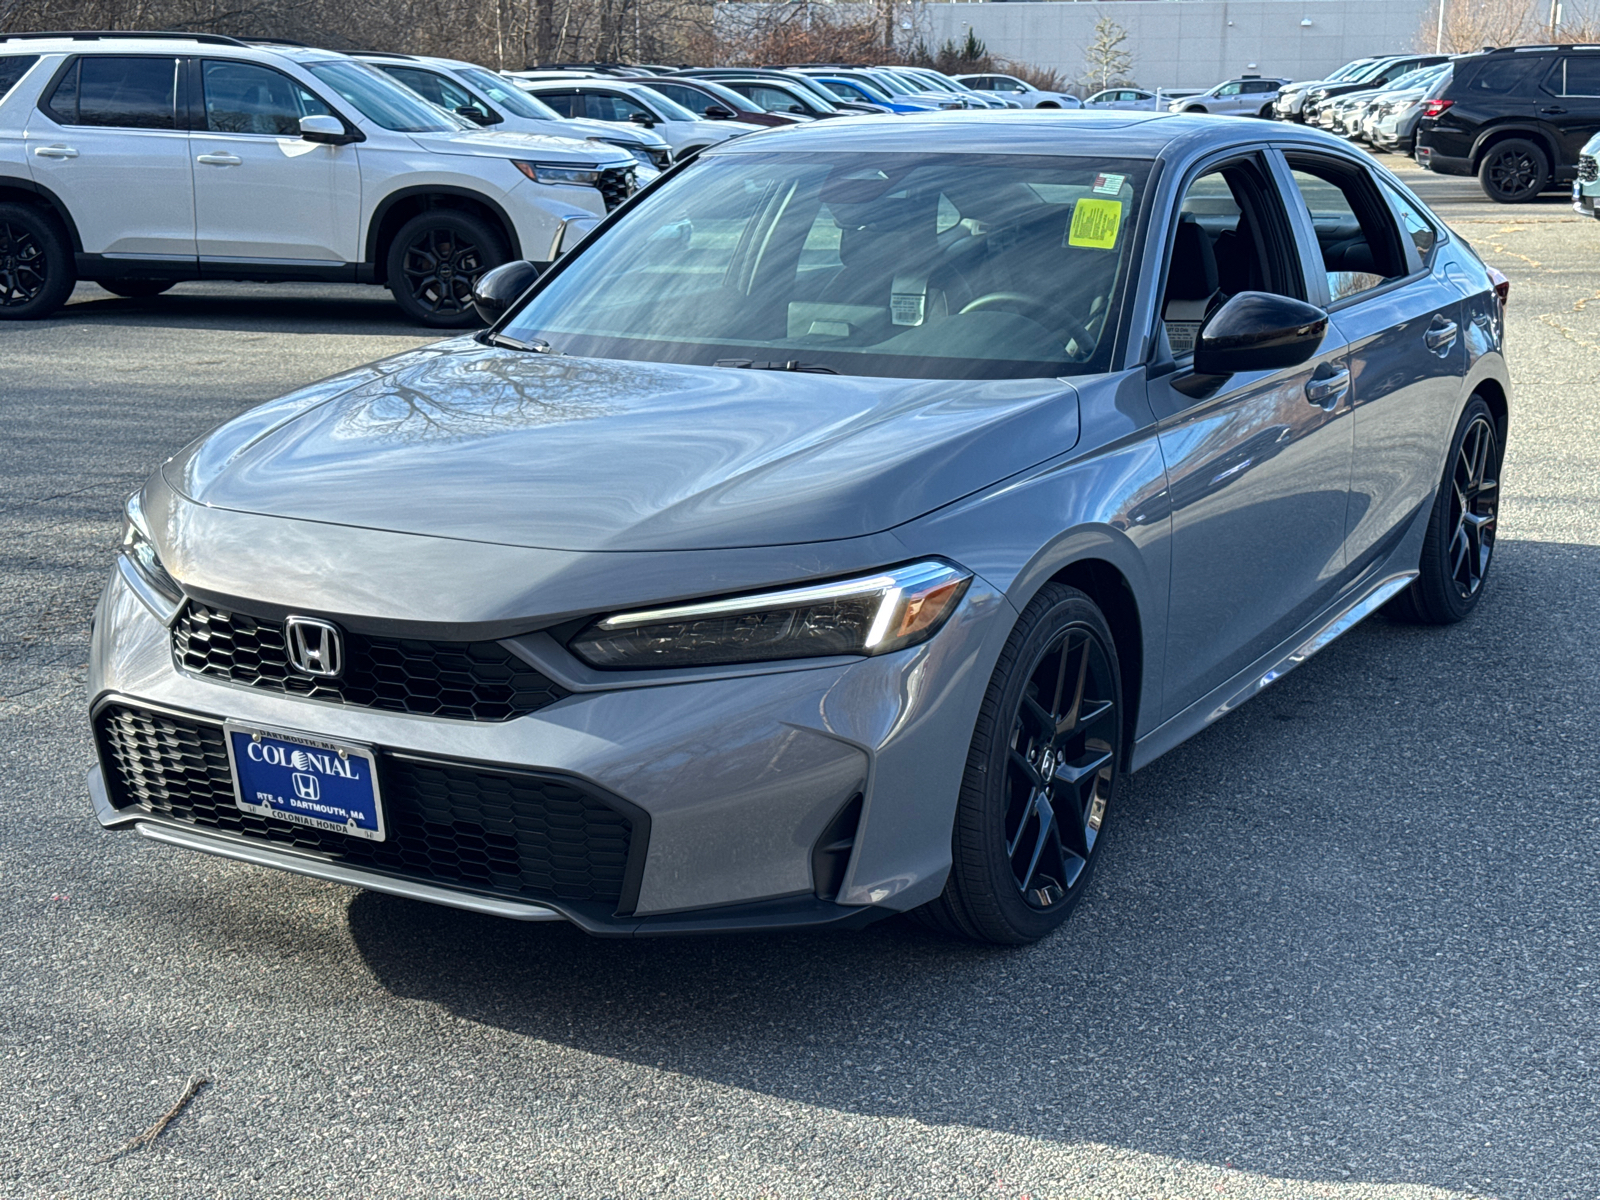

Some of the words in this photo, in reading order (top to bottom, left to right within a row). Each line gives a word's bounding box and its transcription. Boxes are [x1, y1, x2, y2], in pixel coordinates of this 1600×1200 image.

[321, 741, 335, 750] MA
[247, 742, 359, 780] COLONIAL
[256, 791, 276, 803] RTE.
[277, 796, 284, 804] 6
[290, 799, 348, 818] DARTMOUTH,
[350, 811, 365, 820] MA
[272, 811, 314, 826] COLONIAL
[316, 820, 348, 834] HONDA
